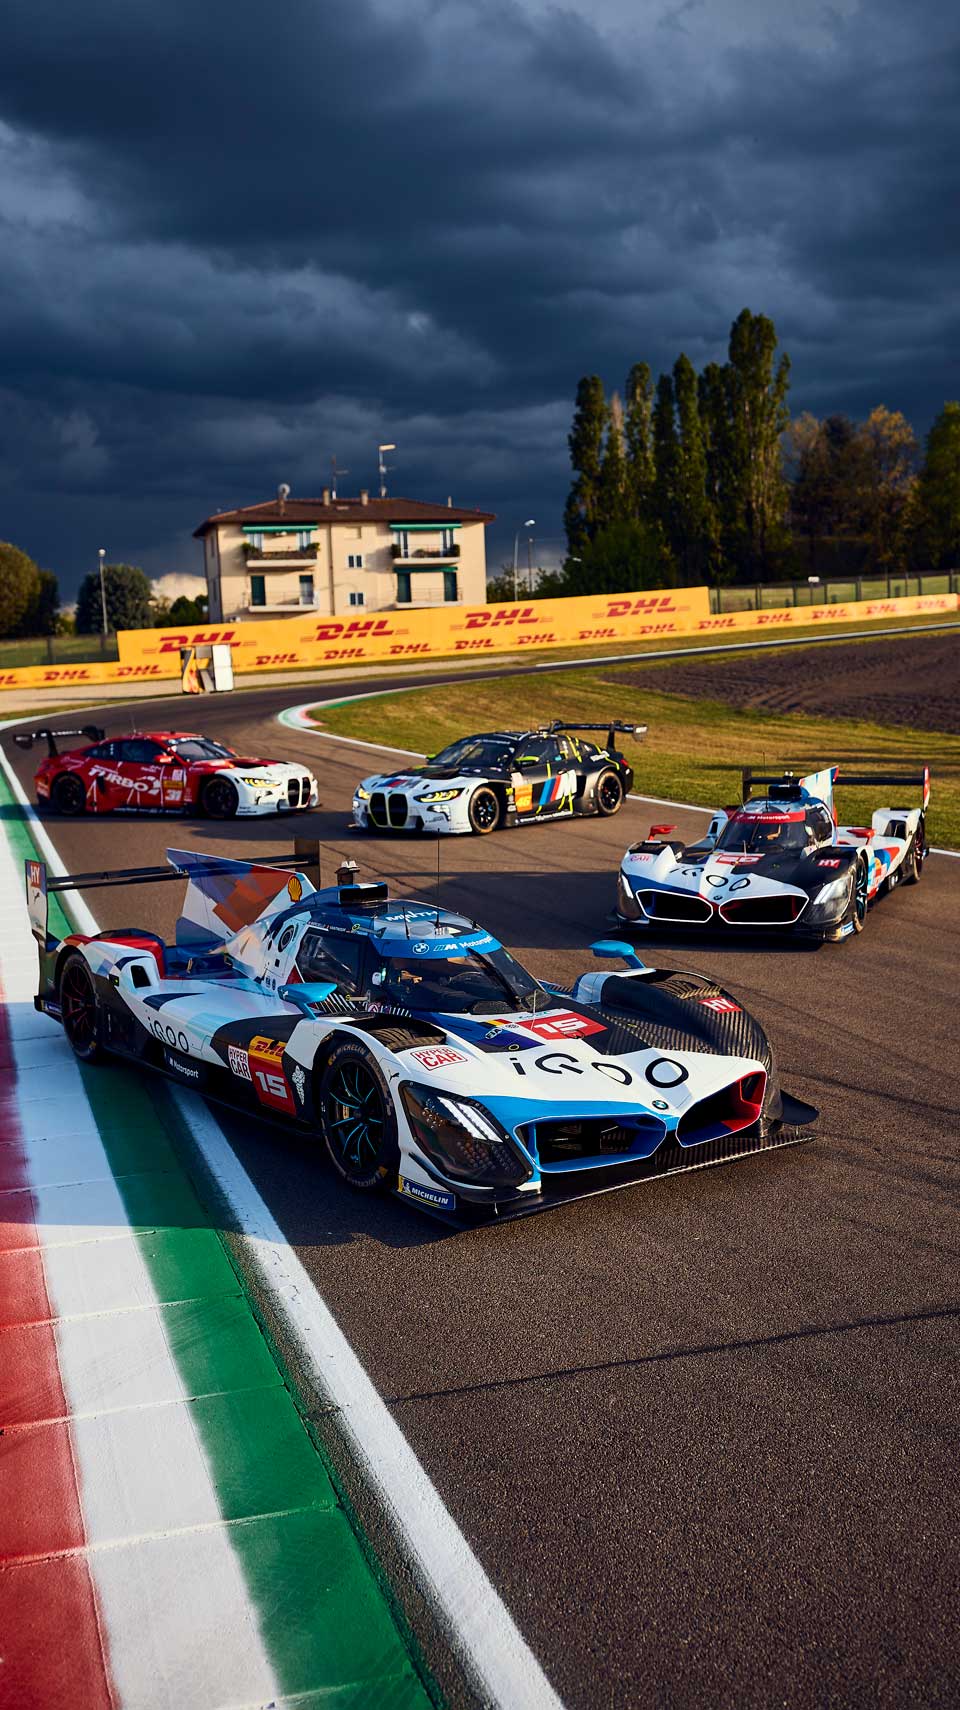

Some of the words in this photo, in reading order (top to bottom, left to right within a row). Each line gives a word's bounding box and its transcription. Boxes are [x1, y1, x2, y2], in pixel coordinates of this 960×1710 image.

[607, 597, 676, 617] DHL
[465, 608, 539, 629] DHL
[699, 618, 736, 630] DHL
[757, 613, 792, 624] DHL
[316, 620, 394, 641] DHL
[579, 629, 617, 640] DHL
[640, 624, 677, 635] DHL
[160, 632, 240, 653] DHL
[455, 638, 495, 650] DHL
[517, 633, 557, 645] DHL
[324, 648, 366, 660] DHL
[390, 643, 431, 655] DHL
[256, 654, 299, 665] DHL
[44, 670, 90, 681] DHL
[117, 665, 161, 676] DHL
[30, 865, 41, 884] HY
[703, 998, 735, 1011] HY
[534, 1018, 588, 1033] 15
[486, 1028, 501, 1039] FIA
[229, 1048, 247, 1062] HYPER
[415, 1048, 452, 1059] HYPER
[423, 1053, 463, 1067] CAR
[231, 1059, 251, 1080] CAR
[255, 1071, 288, 1099] 15
[412, 1187, 449, 1205] MICHELIN
